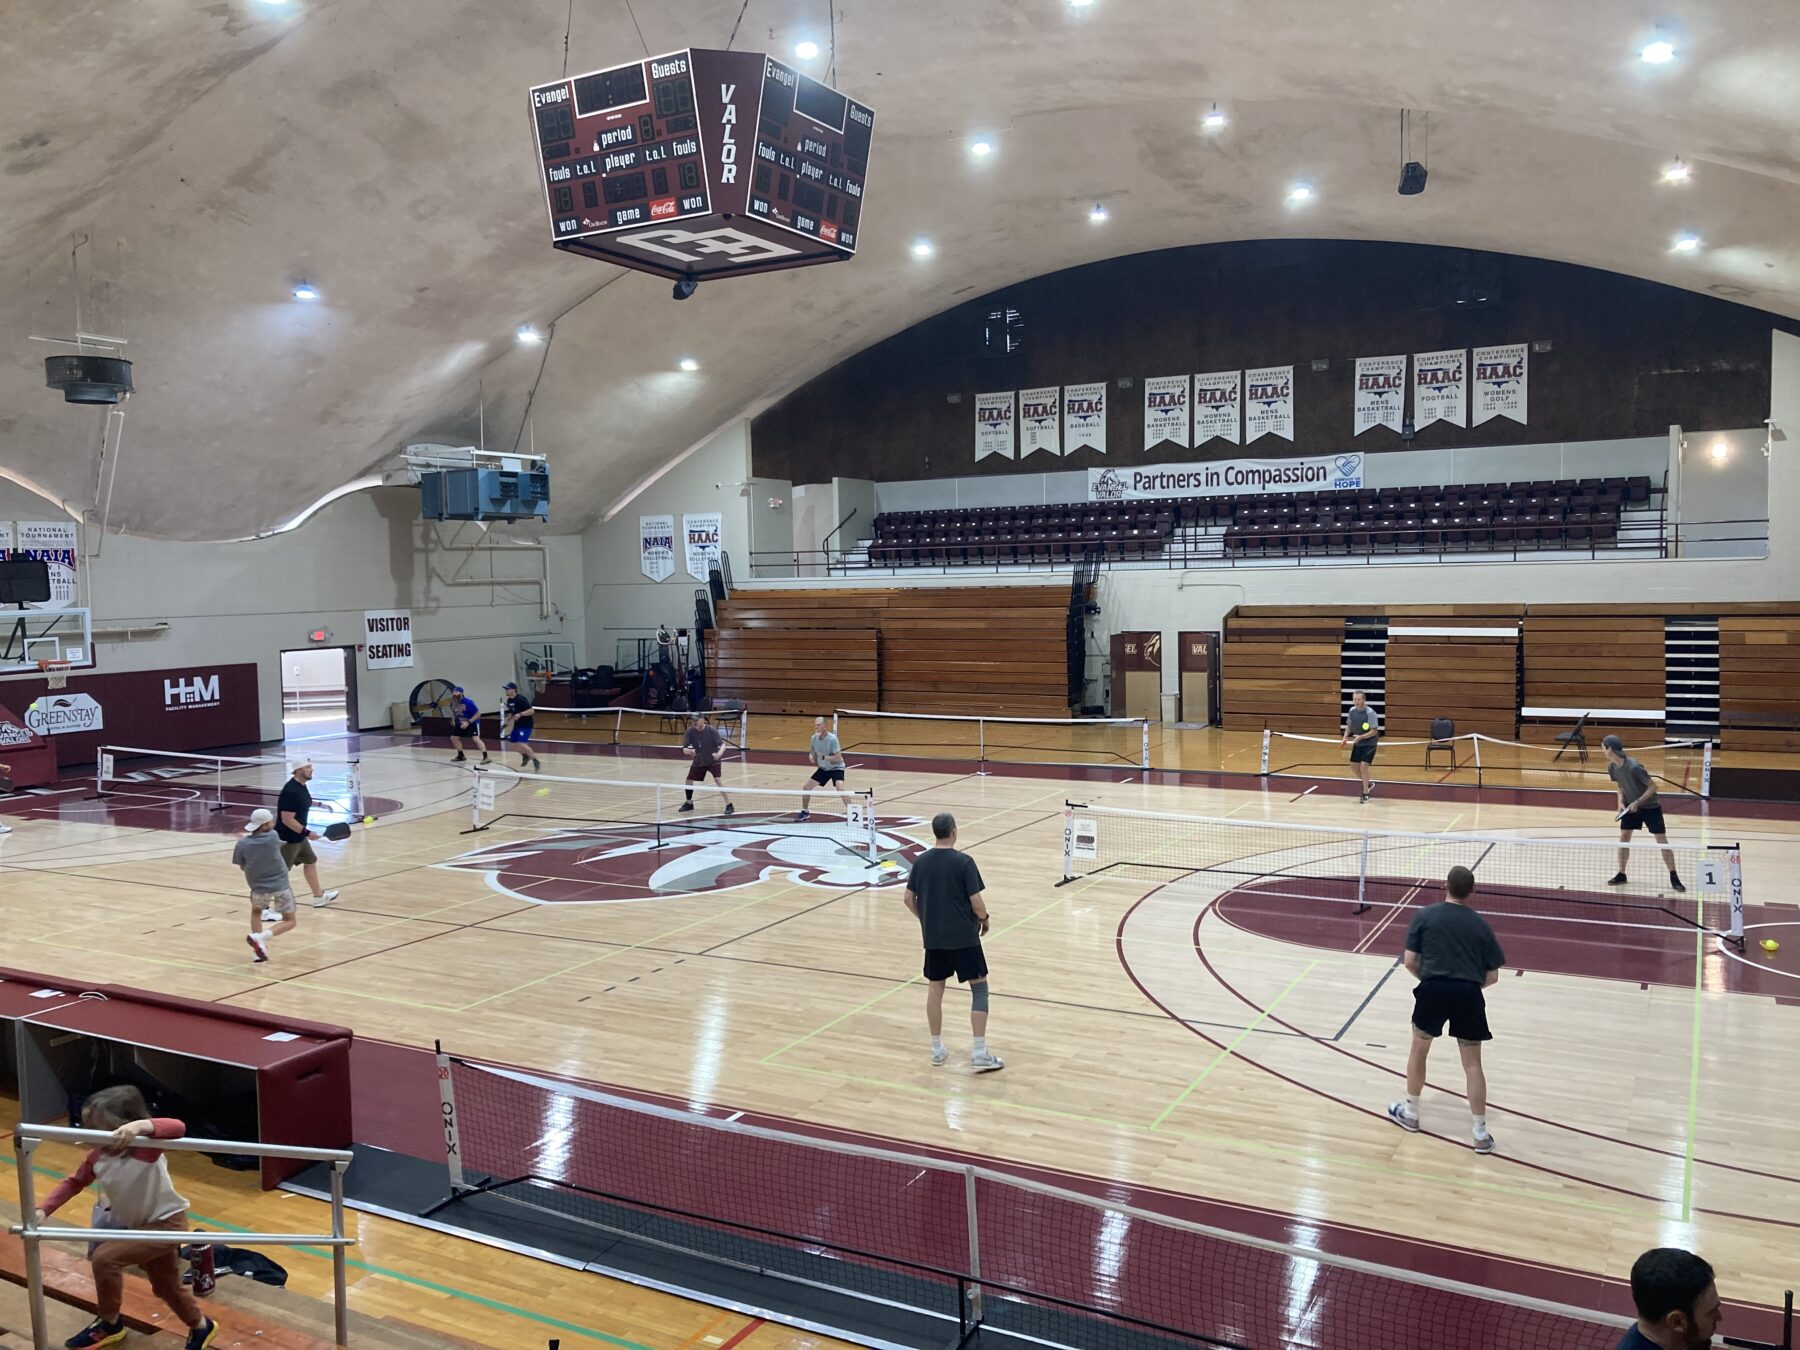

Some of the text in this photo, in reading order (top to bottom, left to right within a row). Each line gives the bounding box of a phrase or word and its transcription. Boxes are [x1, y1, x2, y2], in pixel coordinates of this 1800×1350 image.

[652, 60, 686, 79] Guests
[766, 62, 794, 87] Evangel
[534, 86, 569, 107] Evangel
[850, 105, 872, 127] Guests
[602, 126, 632, 148] period
[720, 84, 737, 184] VALOR
[804, 139, 826, 156] period
[550, 166, 570, 181] fouls
[605, 152, 636, 172] player
[672, 140, 696, 156] fouls
[758, 142, 776, 162] fouls
[801, 162, 824, 180] player
[846, 180, 861, 197] fouls
[651, 202, 676, 216] Coca-Cola
[683, 196, 702, 210] won
[754, 200, 768, 214] won
[616, 208, 640, 224] game
[796, 215, 814, 230] game
[560, 218, 577, 232] won
[841, 232, 853, 244] won
[1416, 353, 1463, 362] CONFERENCE
[1476, 348, 1524, 356] CONFERENCE
[1248, 370, 1290, 378] CONFERENCE
[1417, 370, 1462, 386] HAAC
[1476, 364, 1524, 380] HAAC
[1358, 376, 1402, 390] HAAC
[1198, 390, 1237, 404] HAAC
[1248, 386, 1290, 400] HAAC
[1422, 394, 1460, 402] FOOTBALL
[1067, 401, 1102, 414] HAAC
[1148, 394, 1186, 408] HAAC
[978, 409, 1012, 422] HAAC
[1022, 404, 1057, 419] HAAC
[1248, 414, 1290, 422] BASKETBALL
[1133, 462, 1327, 490] Partners in Compassion
[1092, 482, 1128, 492] EVANGEL
[1334, 480, 1360, 488] HOPE
[1096, 490, 1122, 498] VALOR
[643, 536, 672, 550] NAIA
[688, 533, 718, 544] HAAC
[24, 549, 75, 568] NAIA
[366, 617, 410, 632] VISITOR
[368, 643, 411, 660] SEATING
[1192, 644, 1208, 655] VAL
[28, 706, 98, 728] GREENSTAY
[1704, 761, 1712, 783] ONIX
[349, 780, 354, 788] 3
[852, 812, 859, 822] 2
[1064, 828, 1072, 856] ONIX
[1706, 872, 1716, 885] 1
[1732, 878, 1742, 913] ONIX
[442, 1102, 457, 1156] ONIX
